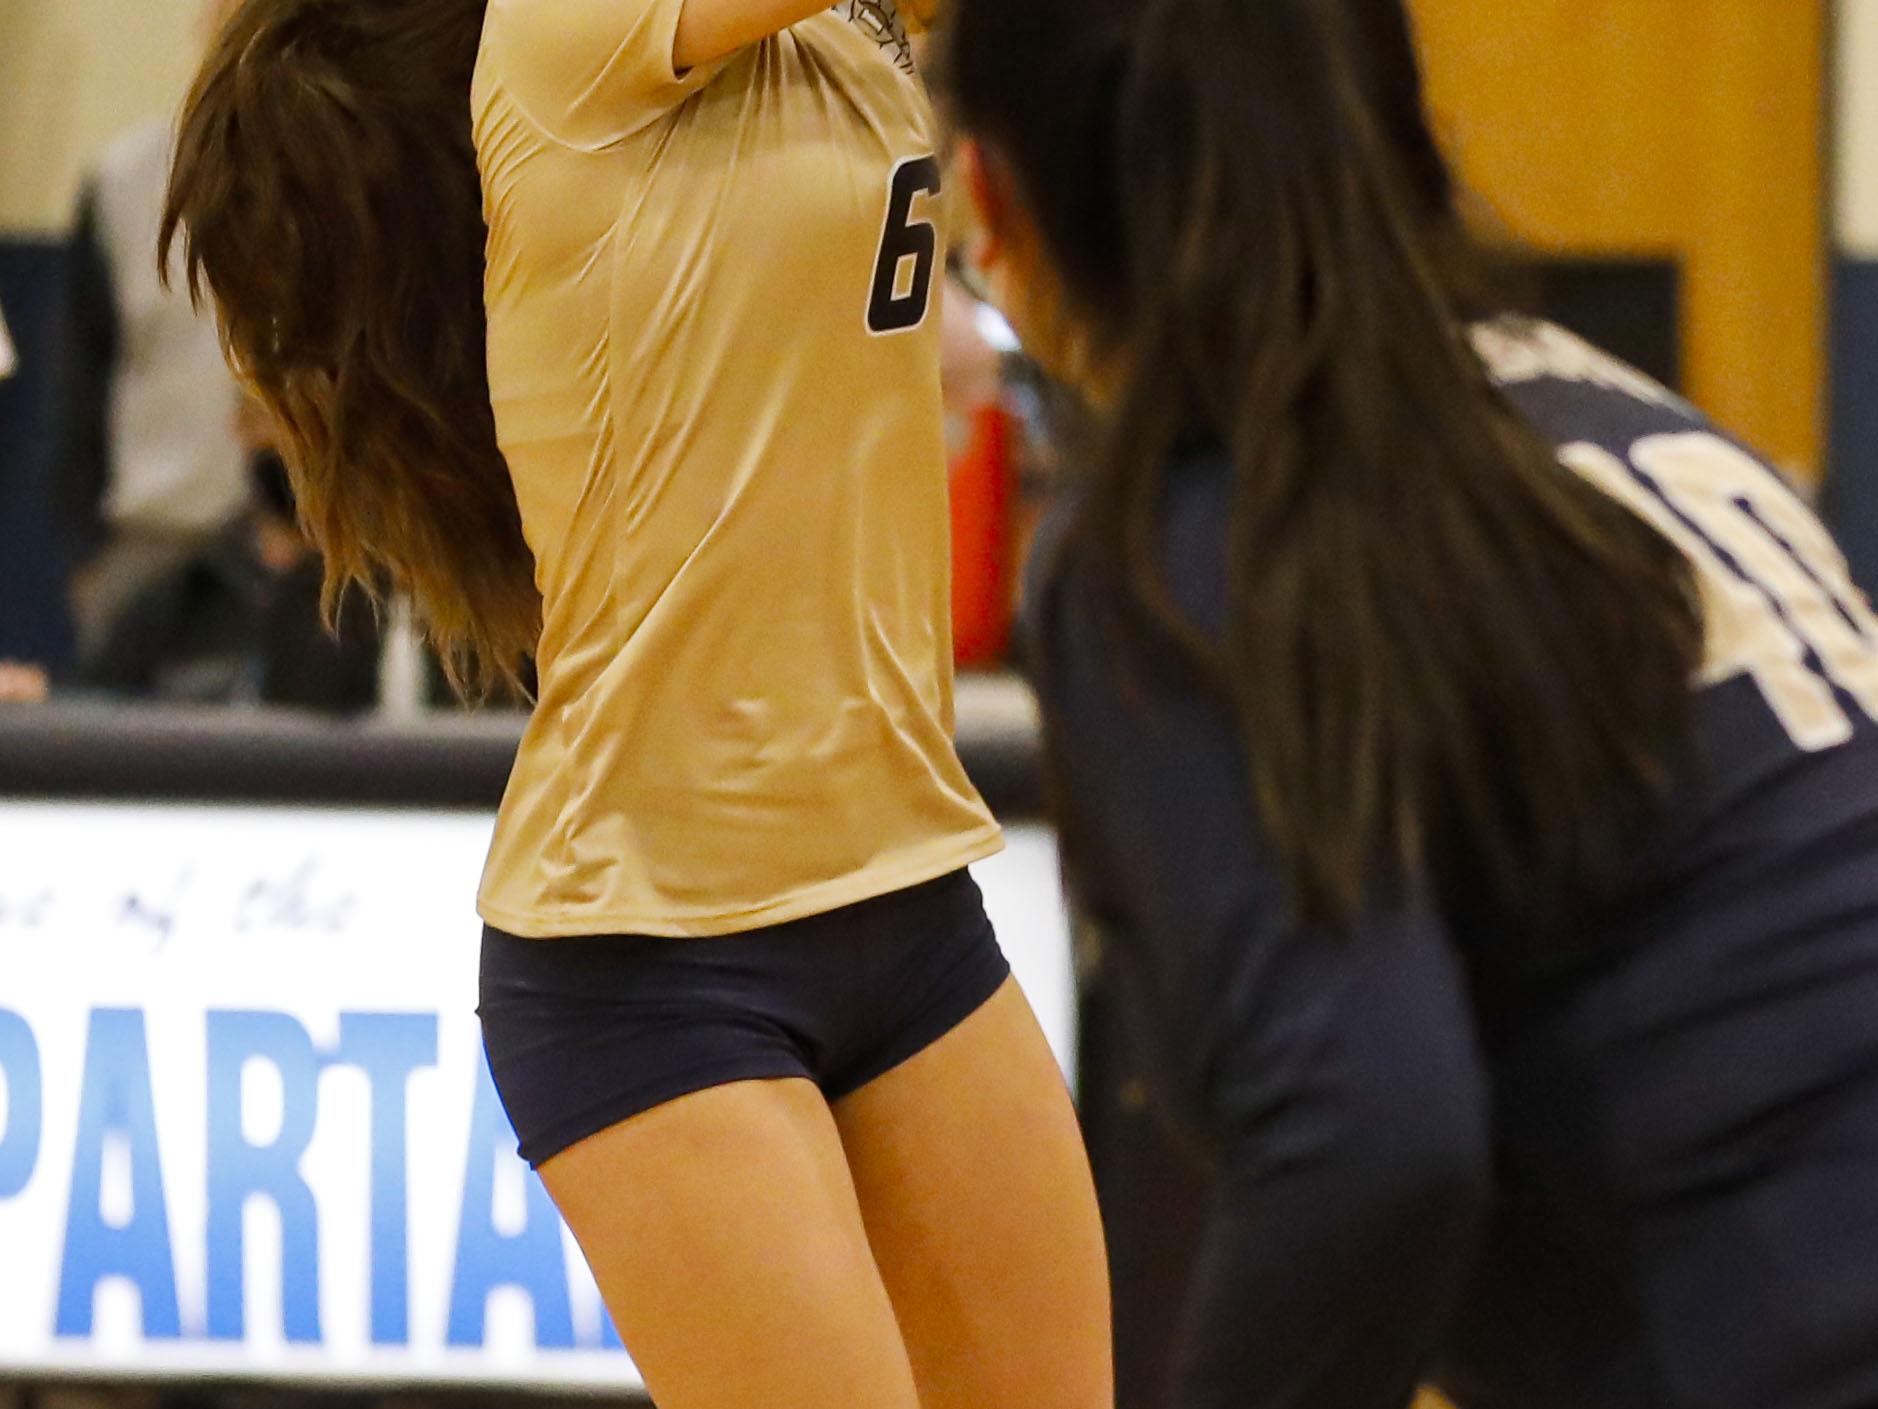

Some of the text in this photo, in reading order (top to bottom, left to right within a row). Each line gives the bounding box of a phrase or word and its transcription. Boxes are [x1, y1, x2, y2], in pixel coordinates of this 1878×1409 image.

[864, 152, 941, 338] 6
[114, 856, 197, 958] of
[232, 848, 357, 934] the
